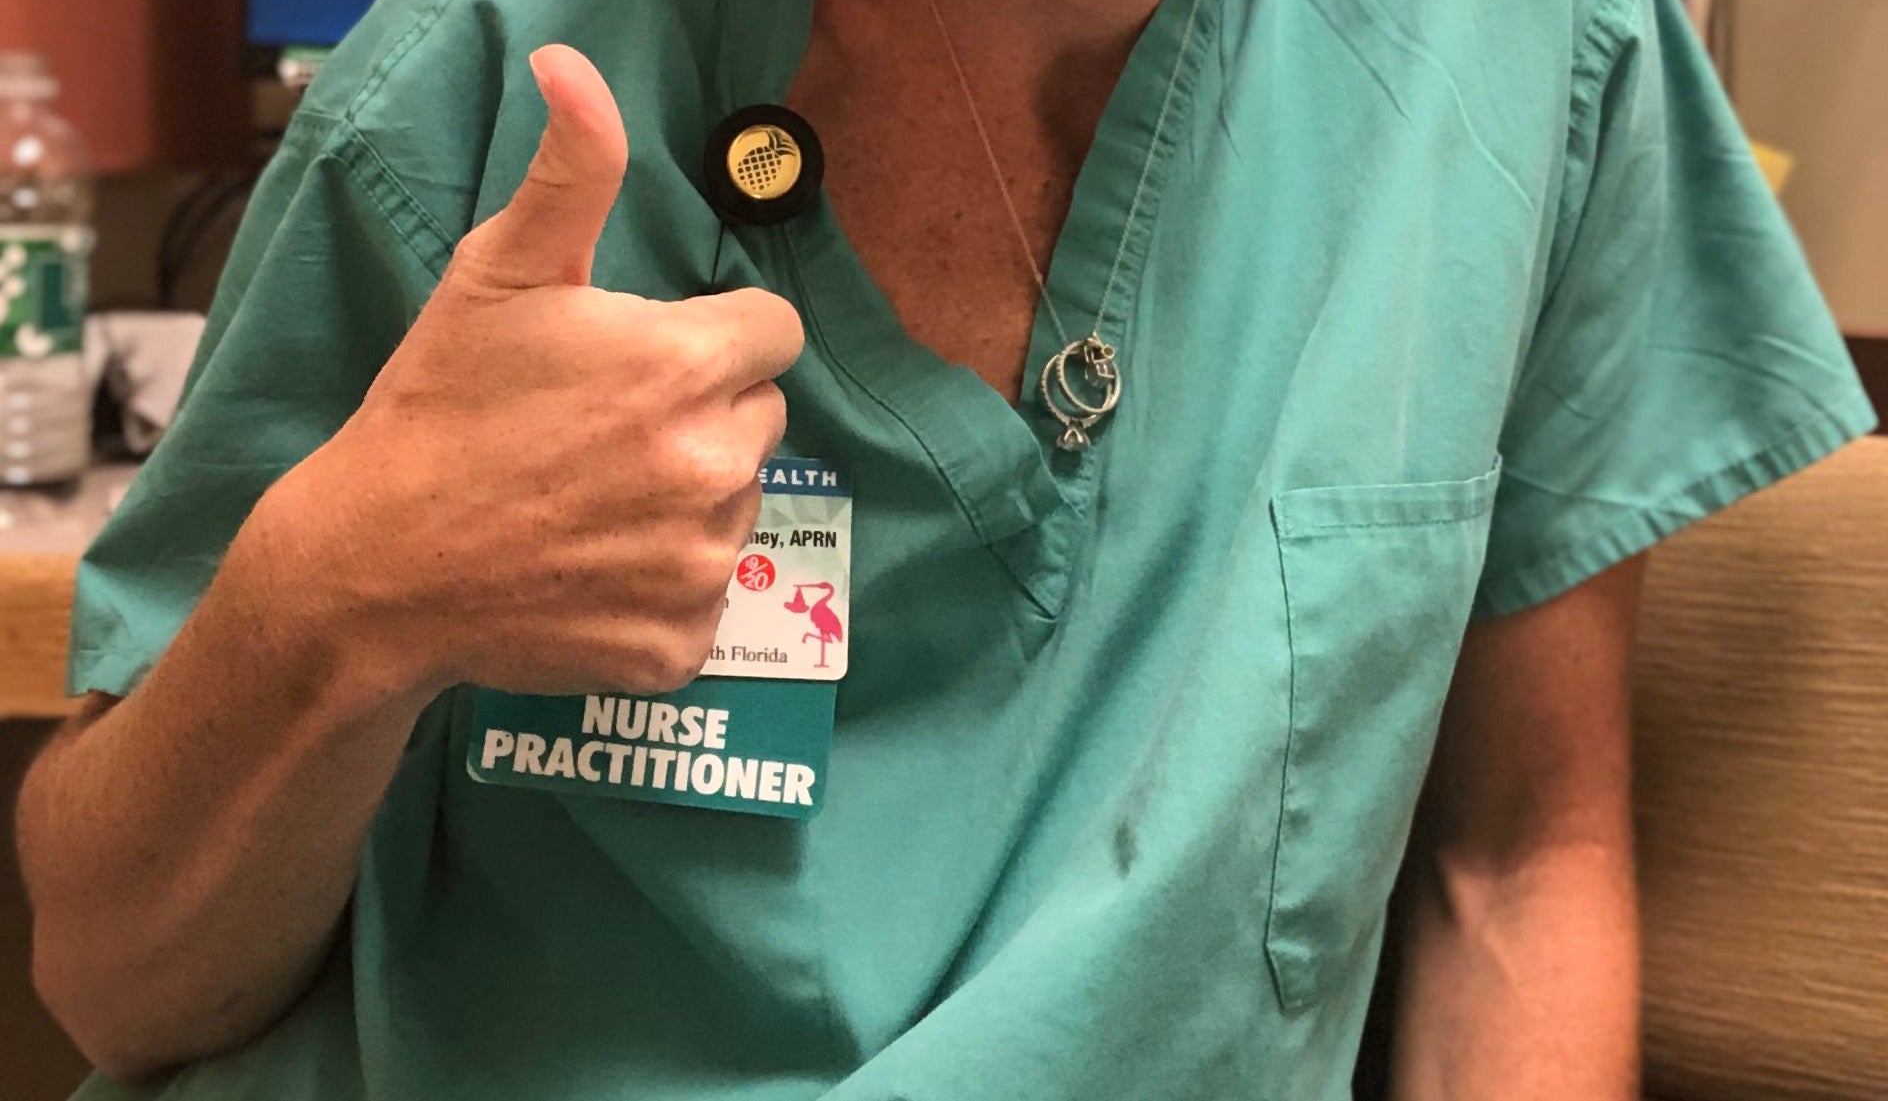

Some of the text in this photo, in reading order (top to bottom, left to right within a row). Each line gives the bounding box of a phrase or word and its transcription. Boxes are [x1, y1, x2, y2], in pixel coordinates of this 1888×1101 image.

[757, 468, 837, 487] EALTH
[748, 529, 837, 549] ney, APRN
[709, 645, 788, 664] th Florida
[581, 695, 730, 750] NURSE
[480, 728, 816, 807] PRACTITIONER
